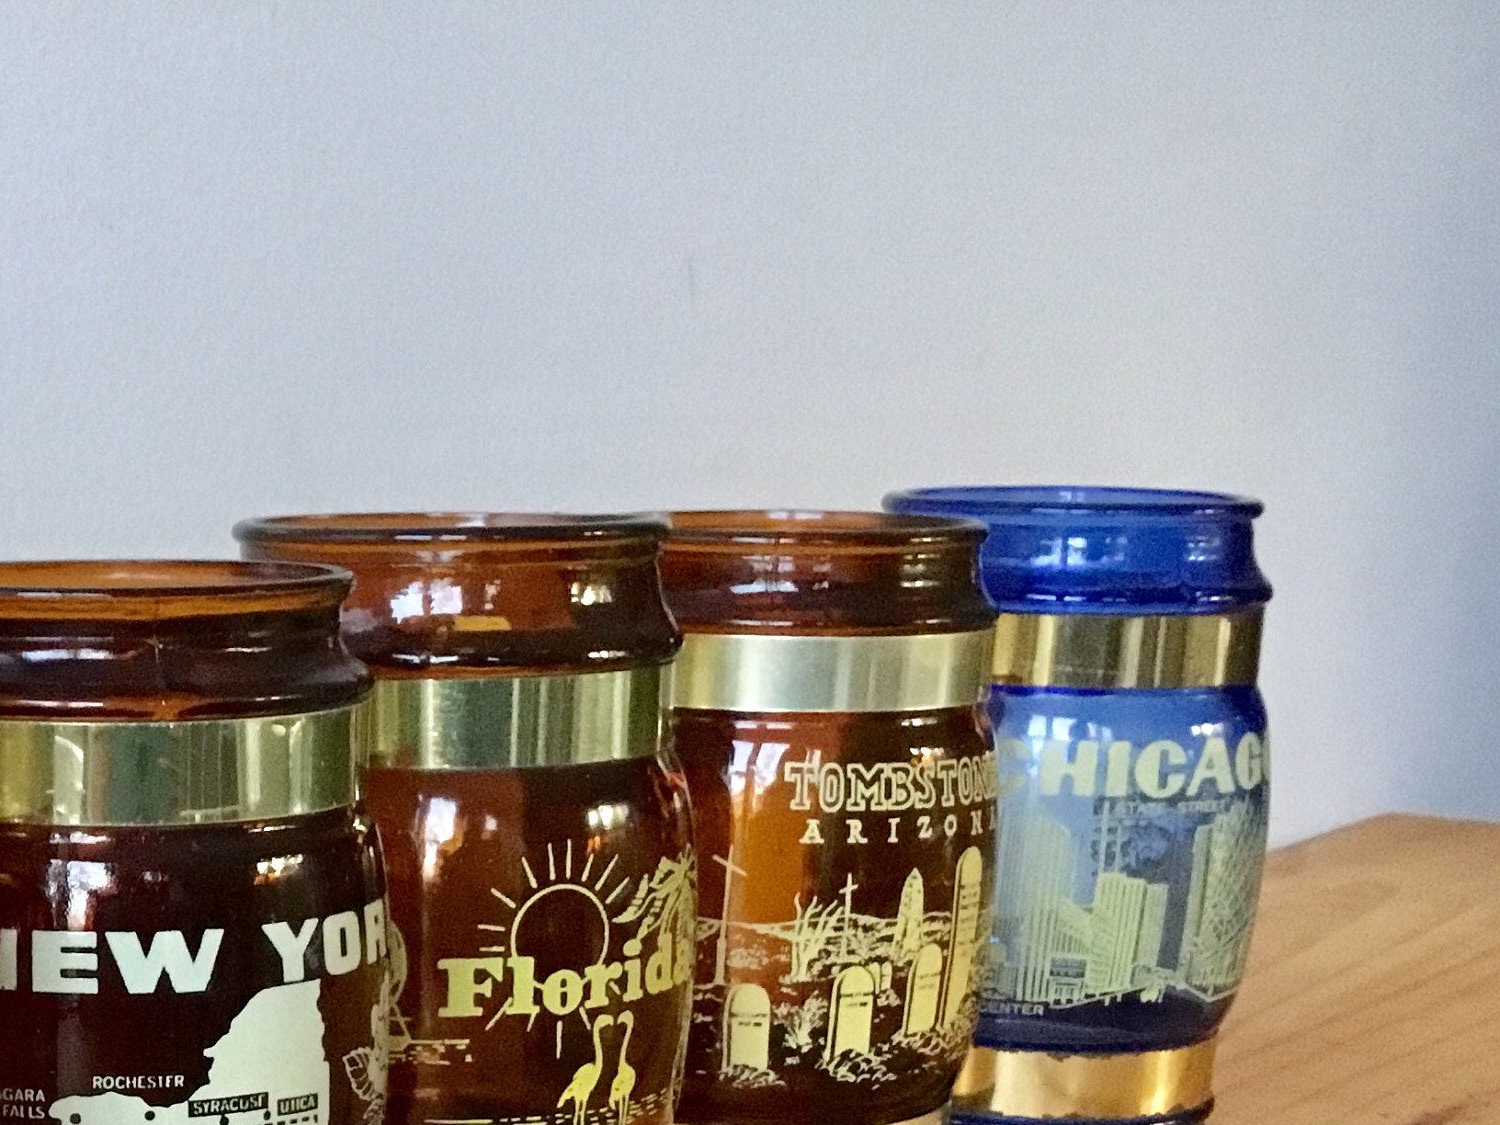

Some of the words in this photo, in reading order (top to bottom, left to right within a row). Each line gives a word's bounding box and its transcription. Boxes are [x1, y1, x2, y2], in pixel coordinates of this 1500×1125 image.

[784, 752, 997, 813] TOMBSTON
[262, 898, 388, 984] YOR
[437, 932, 692, 1017] Florida
[92, 1074, 185, 1089] ROCHESTER
[3, 1104, 45, 1119] FALLS
[192, 1094, 266, 1115] SYRACUSE
